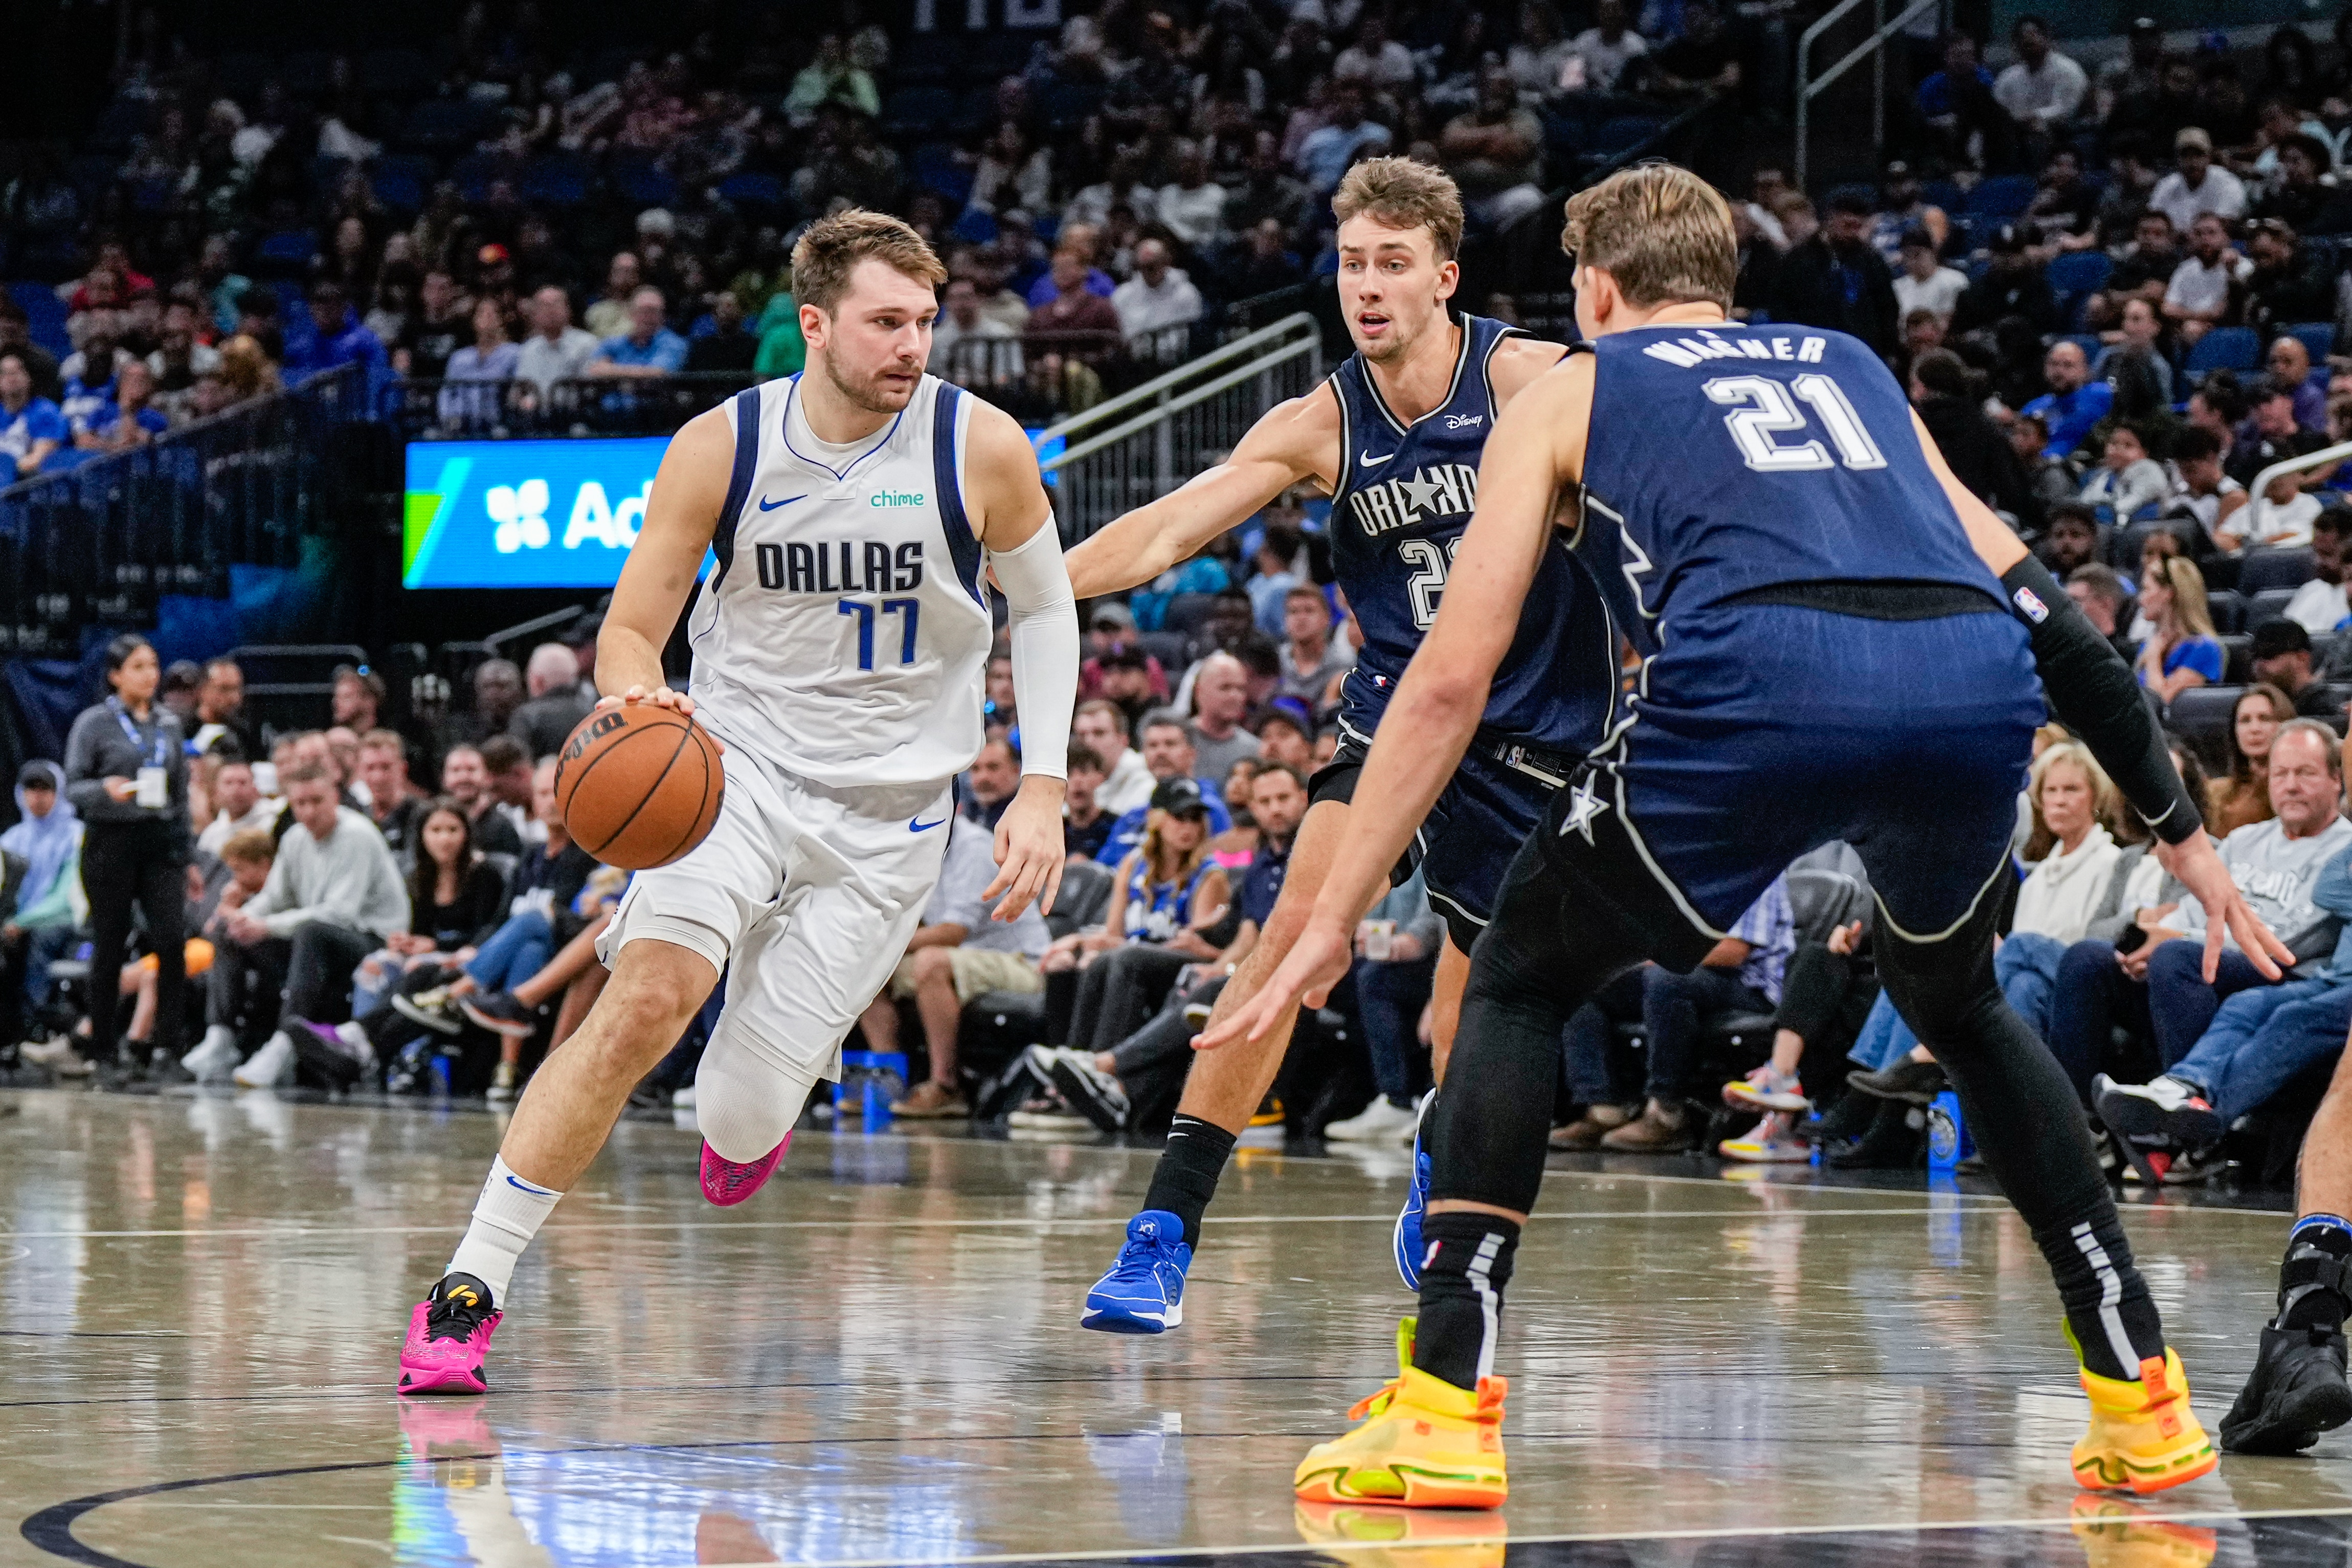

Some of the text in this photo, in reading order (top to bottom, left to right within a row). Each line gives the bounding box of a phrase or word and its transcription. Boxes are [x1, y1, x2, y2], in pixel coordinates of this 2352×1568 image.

[1701, 372, 1888, 473] 21
[562, 479, 655, 549] Ad
[870, 489, 924, 507] chime
[755, 541, 924, 594] DALLAS
[1398, 536, 1464, 631] 2
[837, 597, 920, 672] 77
